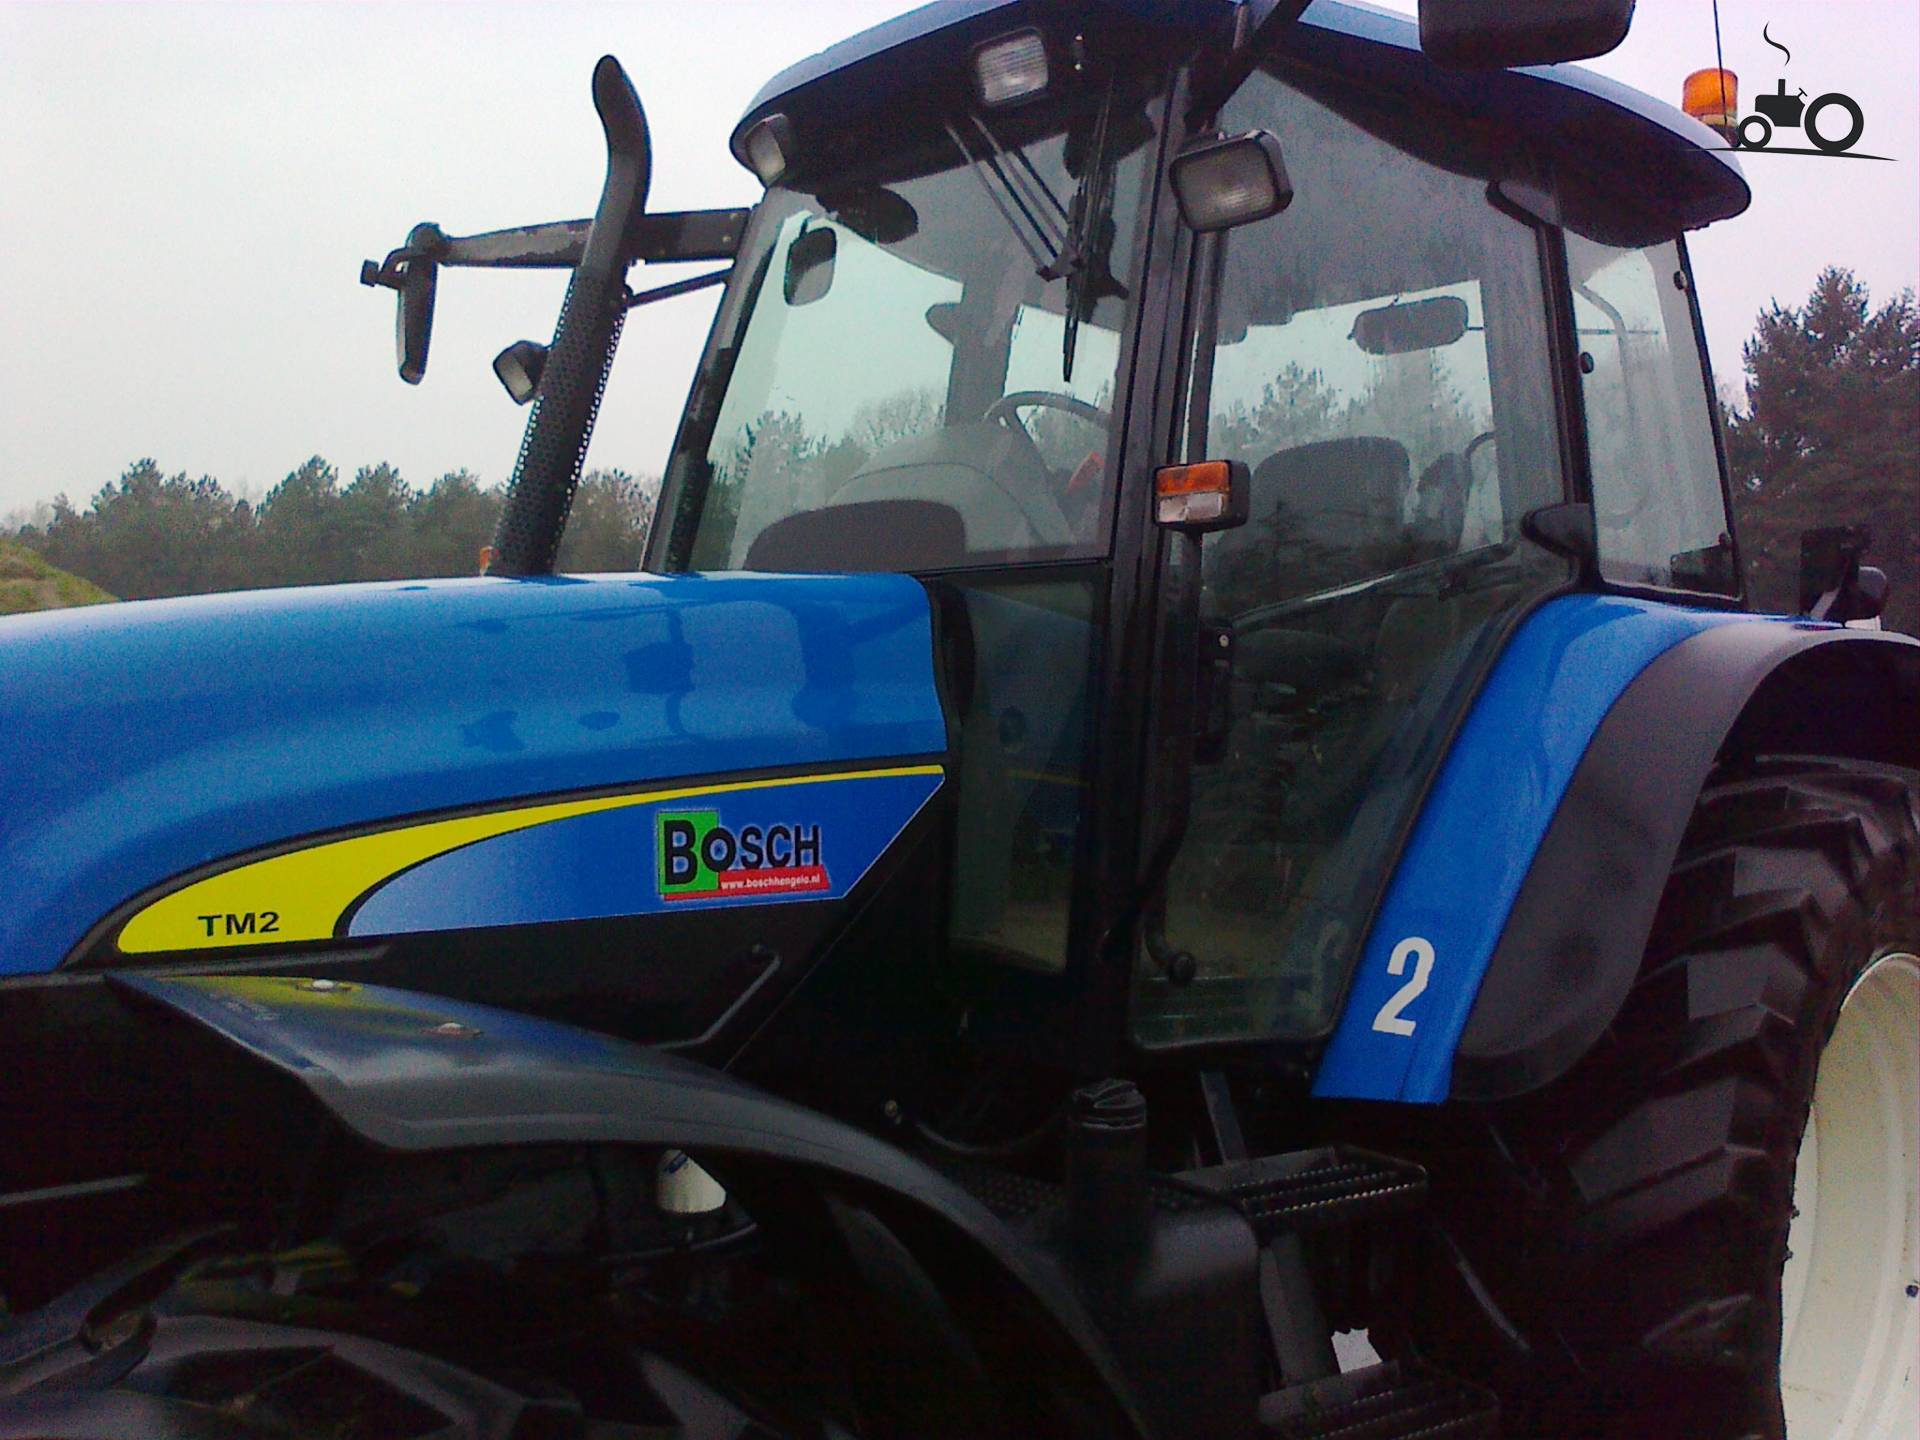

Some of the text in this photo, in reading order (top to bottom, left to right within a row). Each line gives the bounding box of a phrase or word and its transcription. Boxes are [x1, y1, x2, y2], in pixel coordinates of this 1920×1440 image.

[664, 820, 820, 885] BOSCH
[198, 911, 279, 936] TM2
[1372, 936, 1435, 1036] 2
